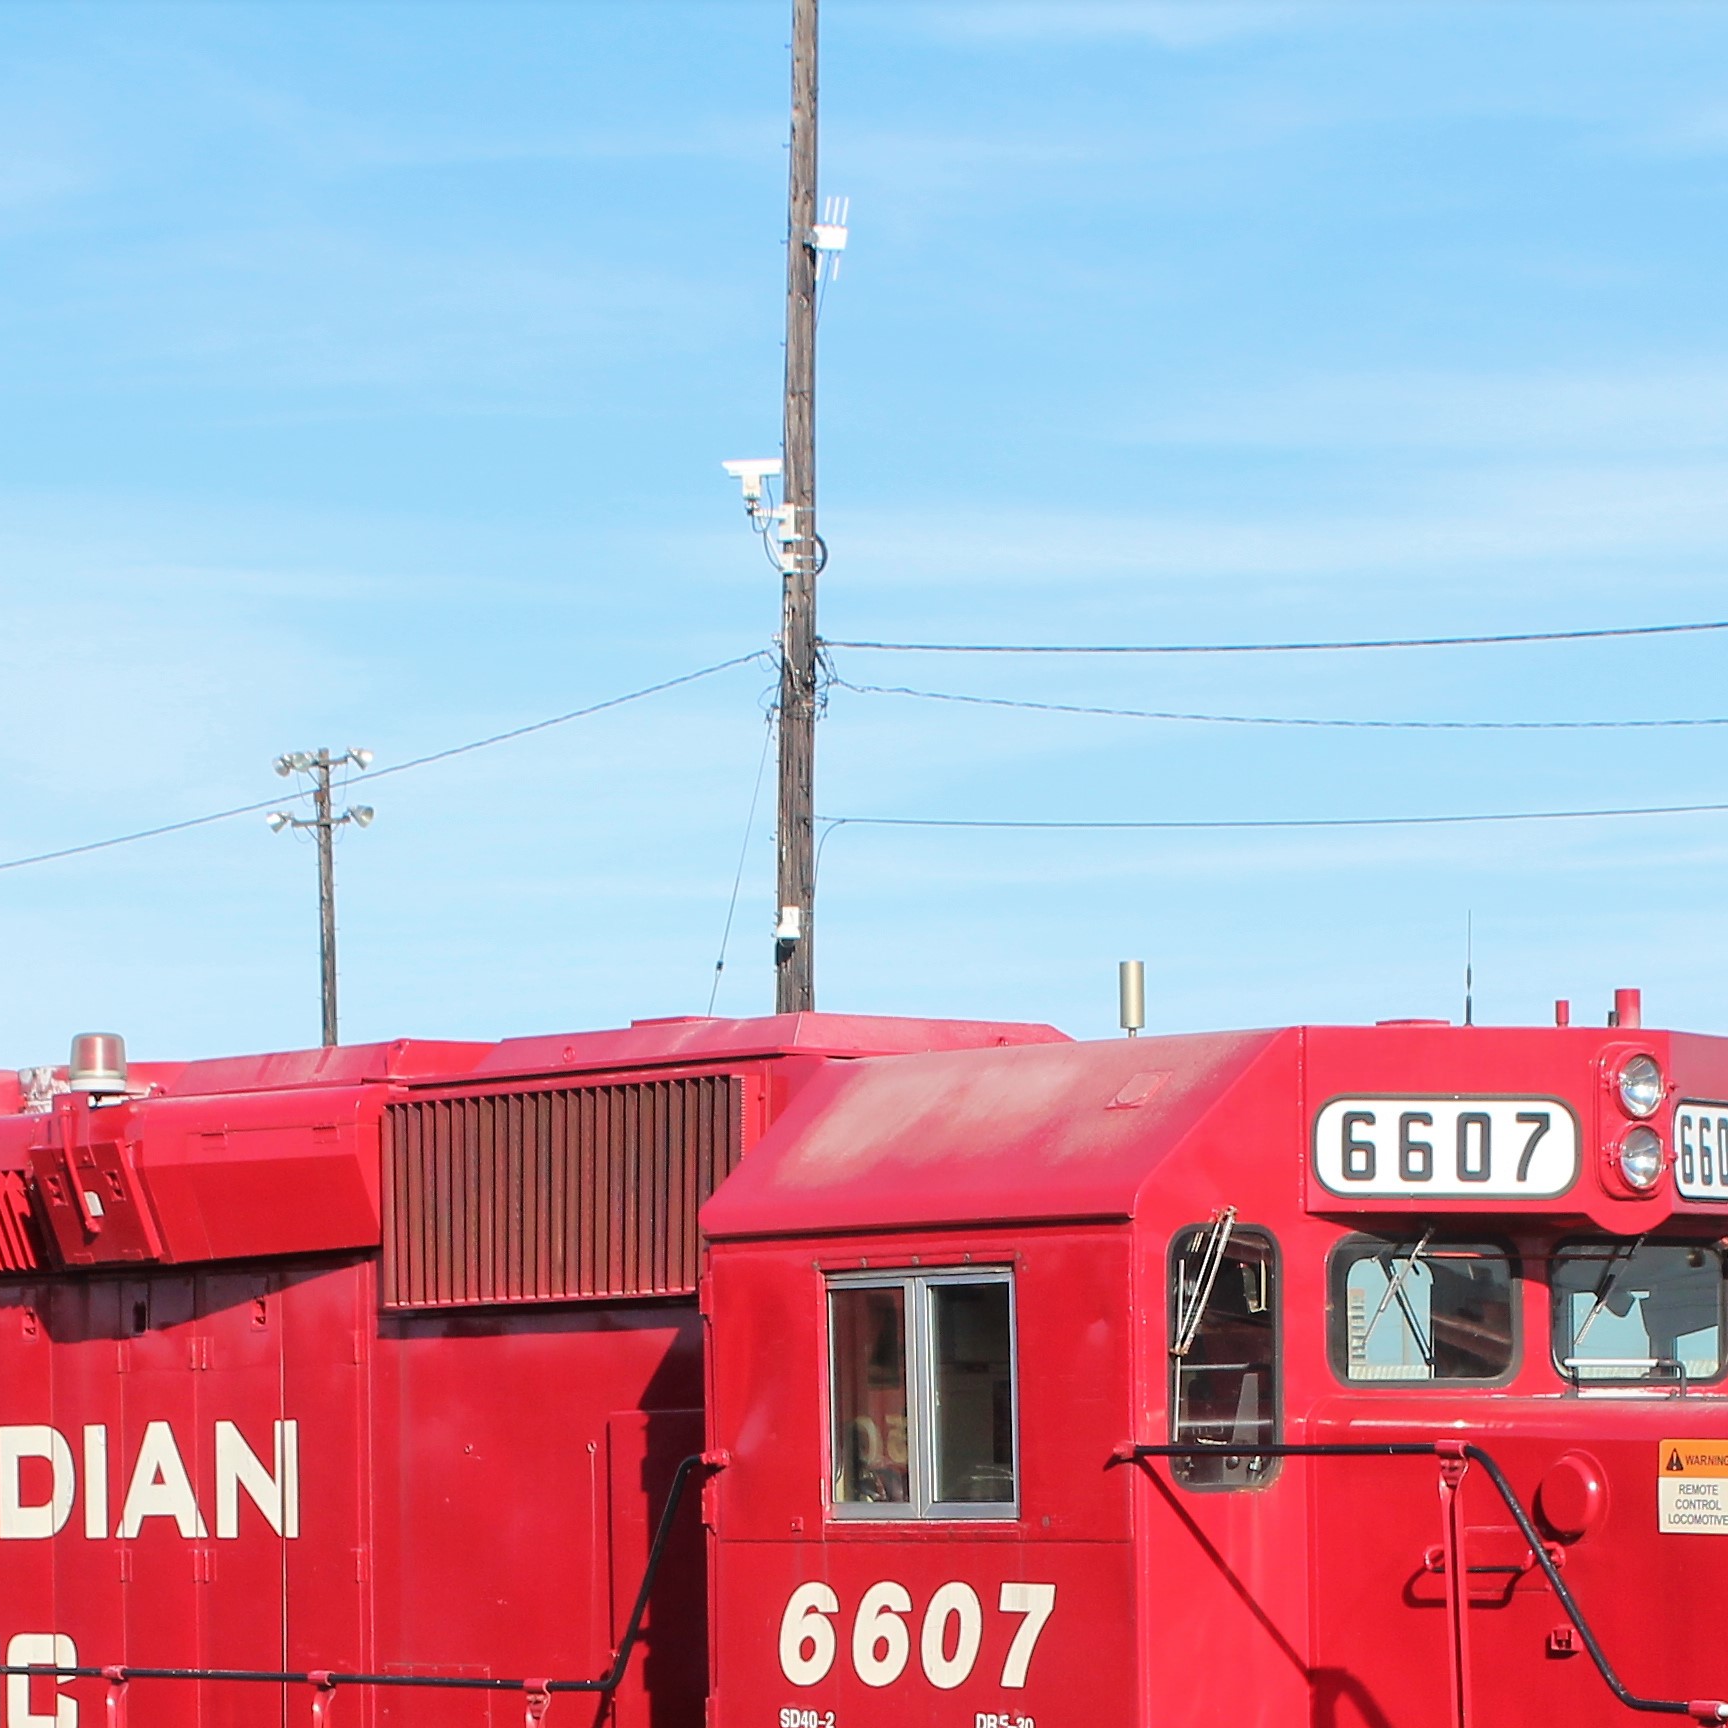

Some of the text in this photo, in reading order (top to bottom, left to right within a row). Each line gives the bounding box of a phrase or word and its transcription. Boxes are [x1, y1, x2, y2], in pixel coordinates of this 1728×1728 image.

[1341, 1111, 1551, 1182] 6607
[1675, 1499, 1722, 1511] CONTROL
[1678, 1484, 1719, 1496] REMOTE
[779, 1581, 1056, 1689] 6607
